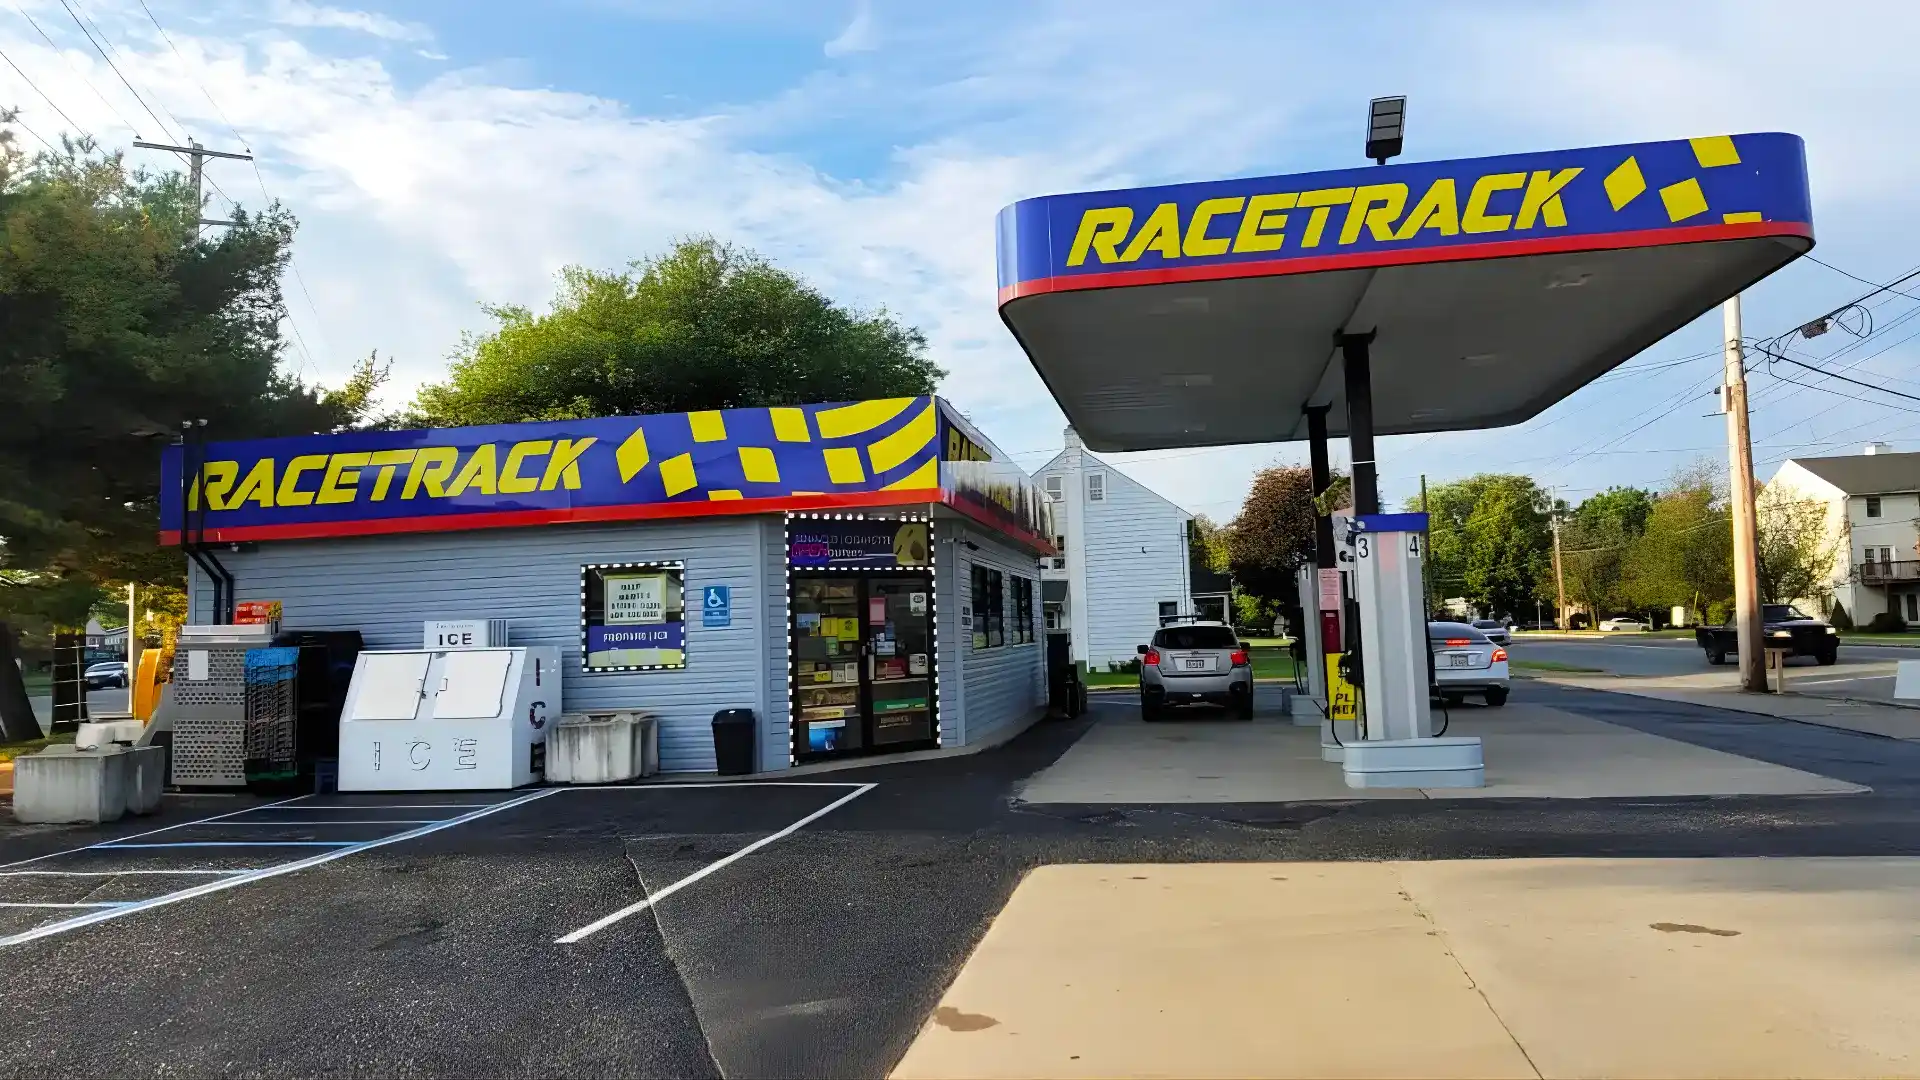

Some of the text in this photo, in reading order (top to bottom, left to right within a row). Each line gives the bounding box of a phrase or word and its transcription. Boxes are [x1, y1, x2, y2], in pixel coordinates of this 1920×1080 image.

[1066, 167, 1584, 268] RACETRACK
[188, 437, 599, 511] RACETRACK
[1358, 538, 1369, 558] 3
[1409, 535, 1420, 558] 4
[439, 632, 473, 646] ICE
[373, 737, 478, 772] ICE
